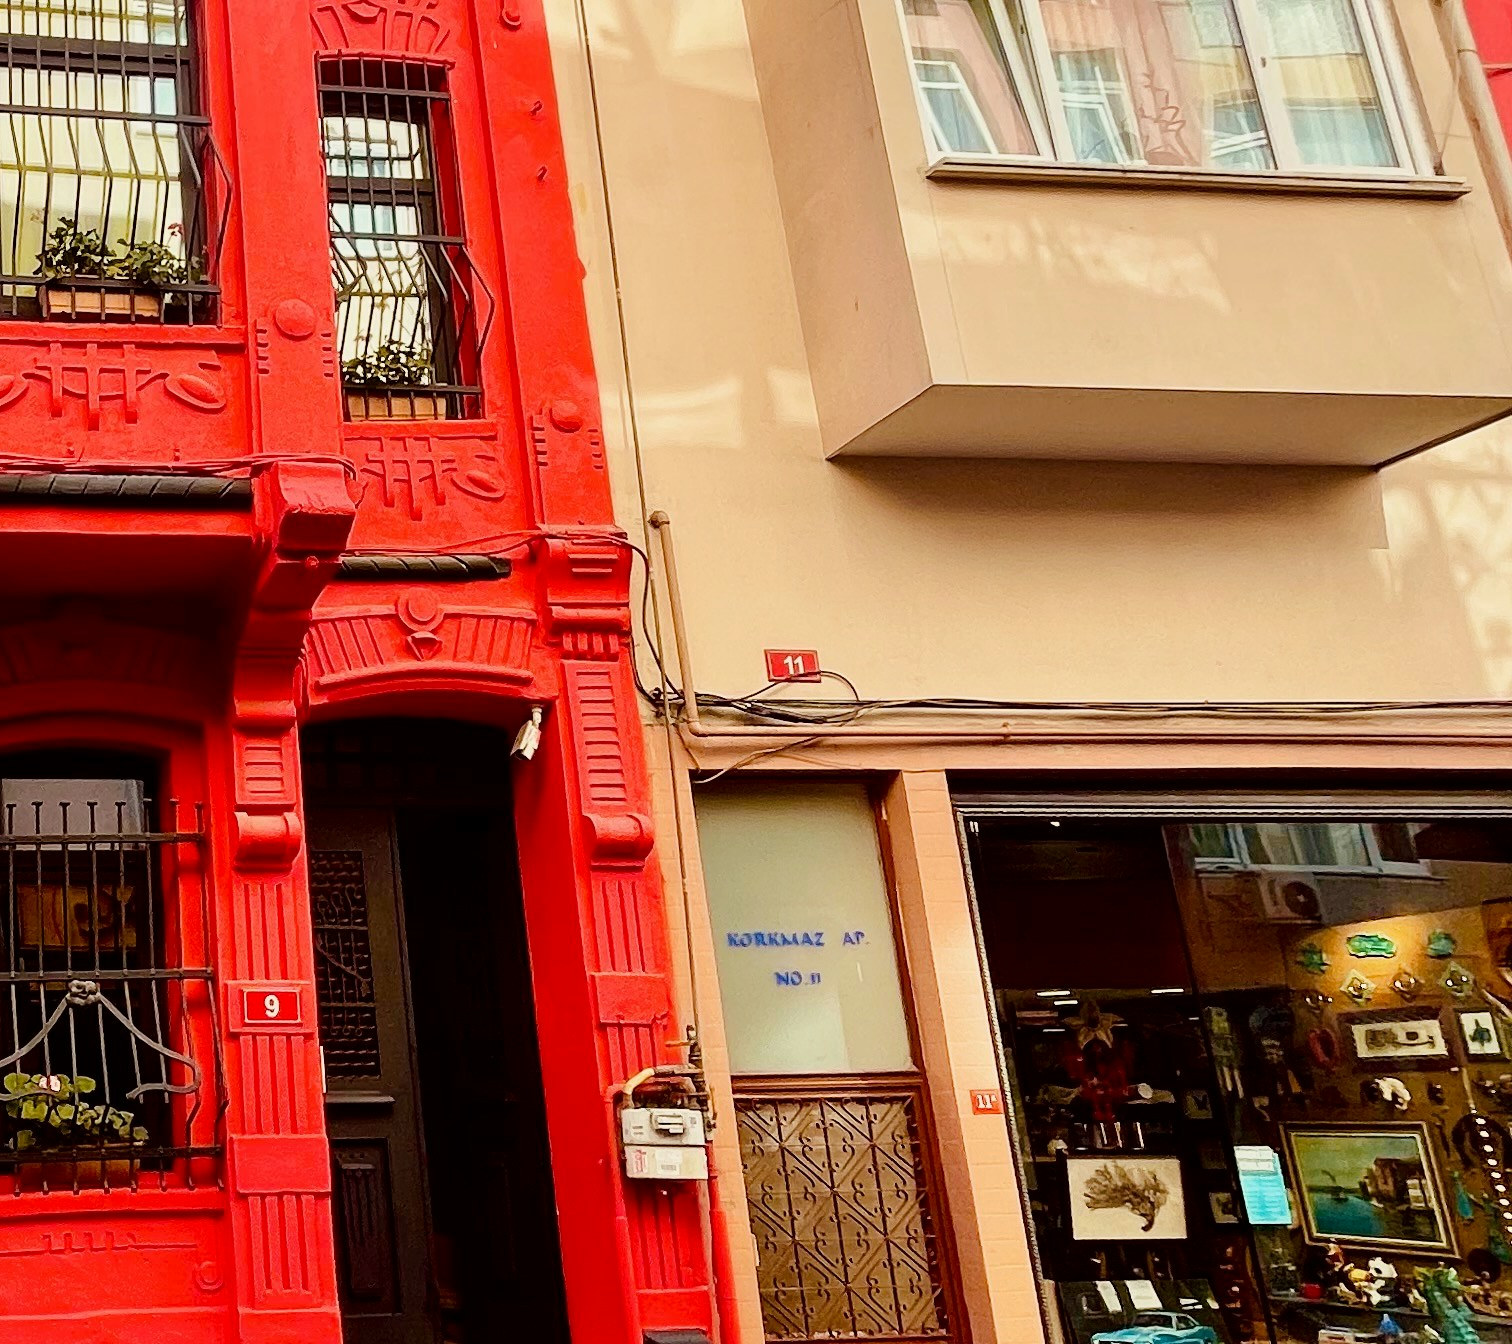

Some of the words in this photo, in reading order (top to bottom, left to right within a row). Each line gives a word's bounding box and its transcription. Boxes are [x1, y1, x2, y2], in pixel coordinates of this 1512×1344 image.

[783, 655, 805, 675] 11
[726, 931, 826, 947] KORKMAZ
[264, 994, 280, 1018] 9
